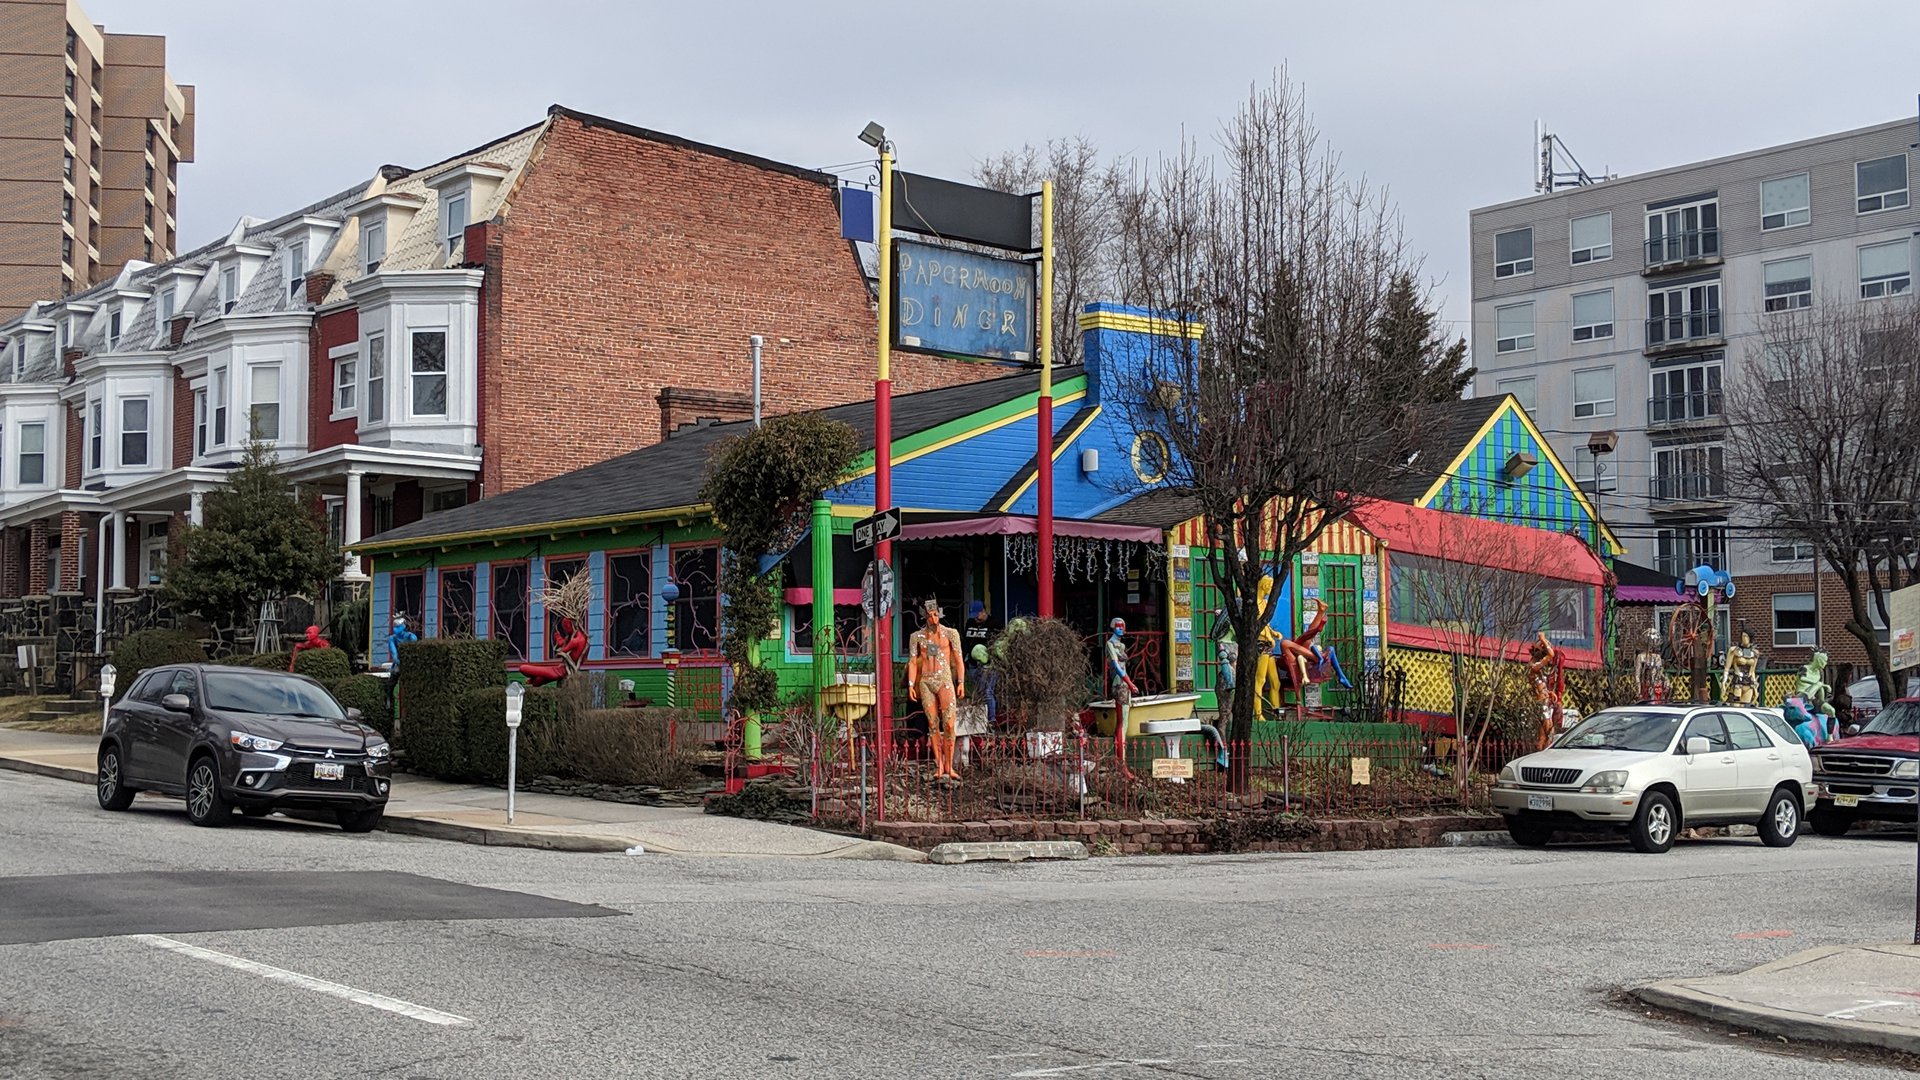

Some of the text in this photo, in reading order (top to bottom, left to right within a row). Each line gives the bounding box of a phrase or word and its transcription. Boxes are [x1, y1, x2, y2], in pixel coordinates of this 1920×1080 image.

[899, 252, 1027, 300] PAPERMOON
[902, 297, 1017, 337] DINER
[857, 521, 886, 540] ONE AY
[686, 682, 723, 696] STAFF
